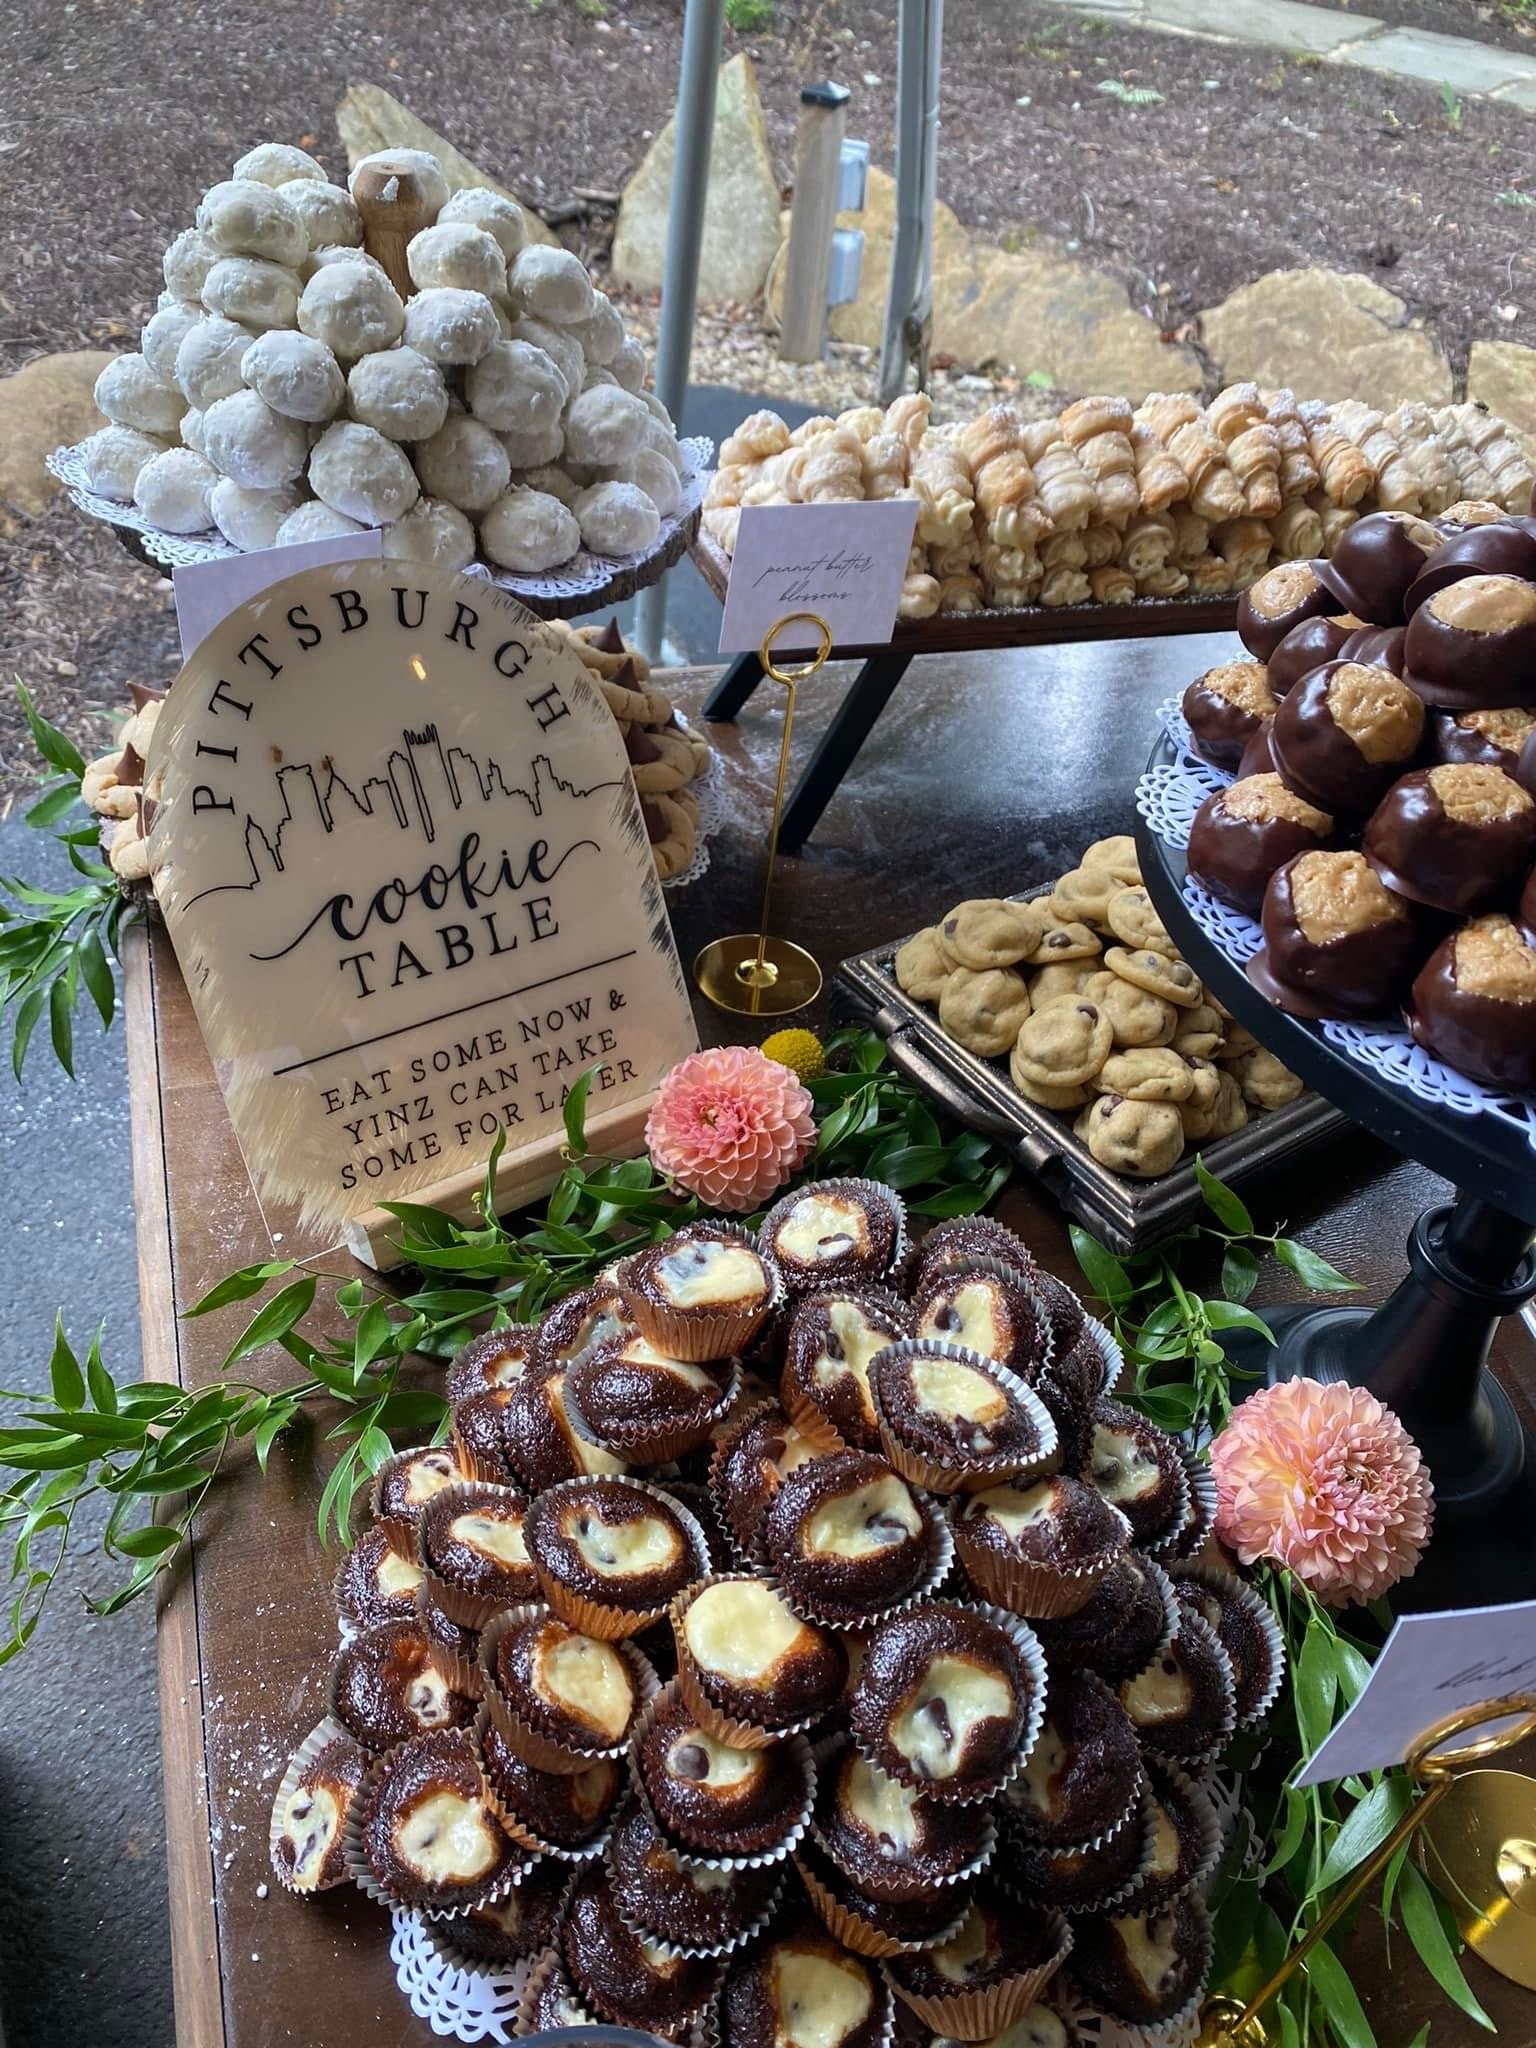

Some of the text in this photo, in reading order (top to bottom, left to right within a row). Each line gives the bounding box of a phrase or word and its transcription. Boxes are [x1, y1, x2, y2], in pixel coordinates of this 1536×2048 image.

[751, 549, 876, 590] peanut butter
[777, 580, 852, 603] blossoms
[191, 586, 572, 816] PITTSBURGH
[250, 832, 601, 960] cookie
[338, 896, 560, 1000] TABLE
[319, 989, 628, 1116] EAT SOME NOW &
[342, 1028, 618, 1146] YINZ CAN TAKE
[340, 1058, 640, 1191] SOME FOR LAER
